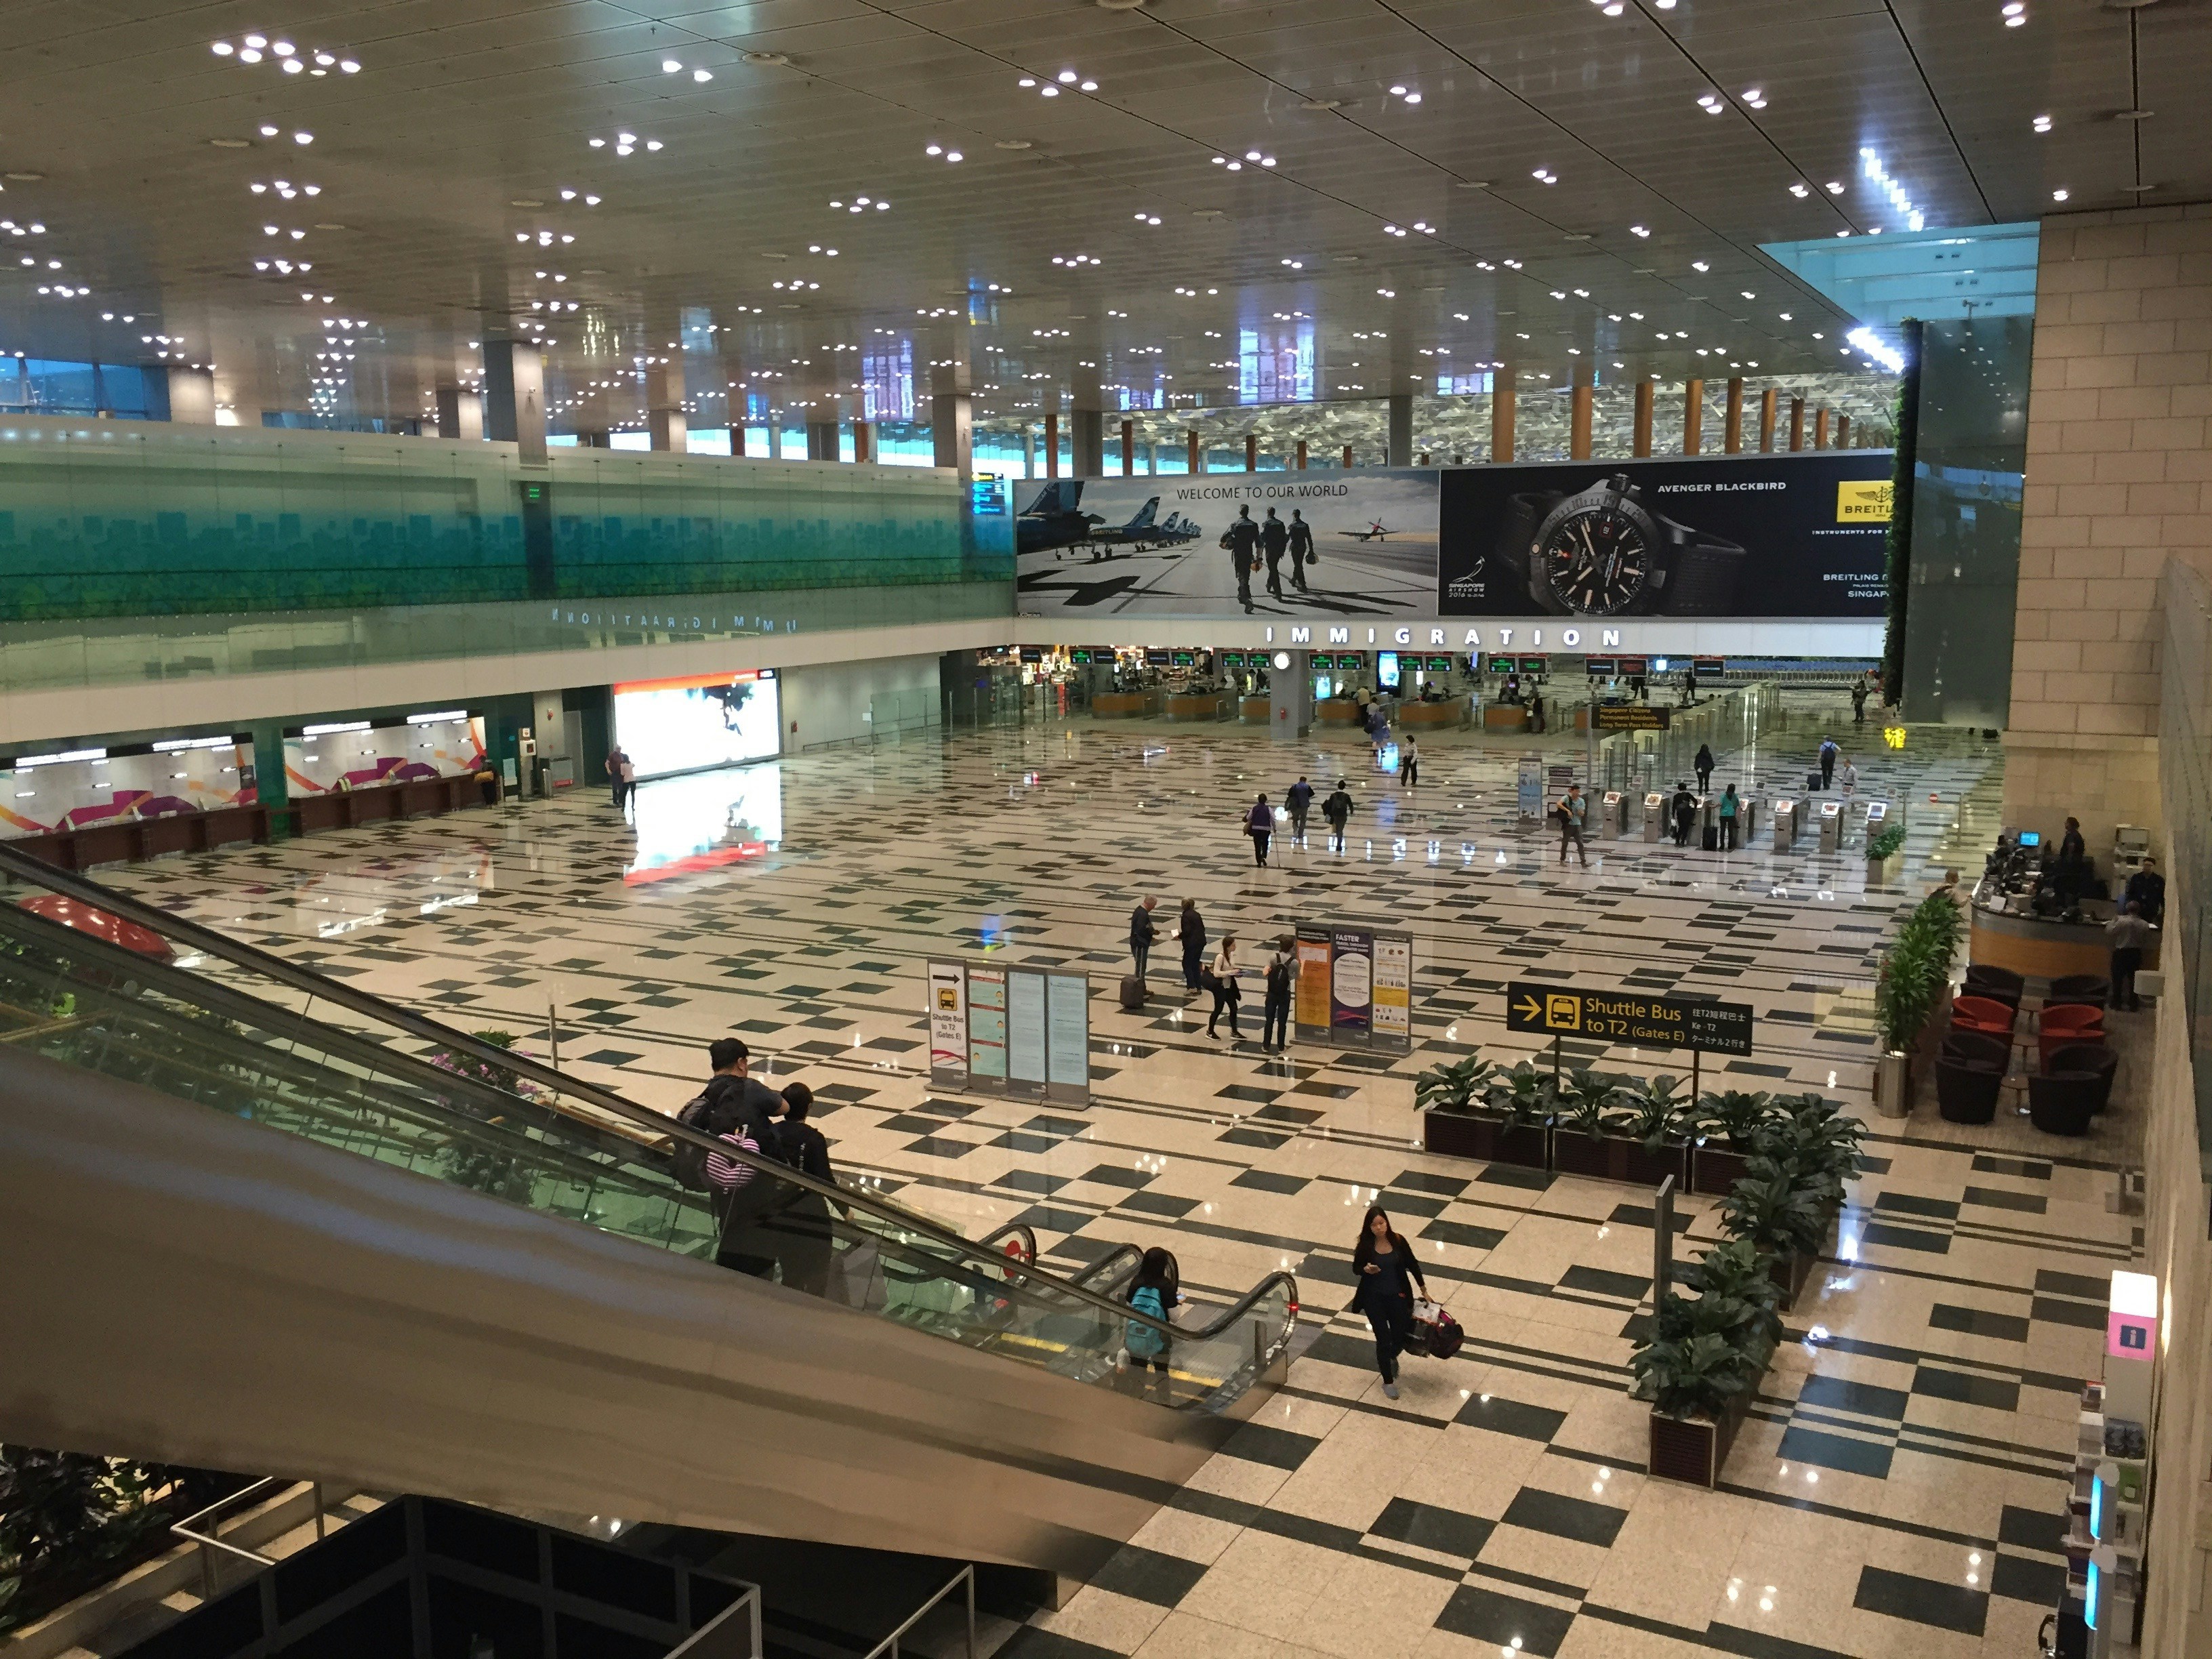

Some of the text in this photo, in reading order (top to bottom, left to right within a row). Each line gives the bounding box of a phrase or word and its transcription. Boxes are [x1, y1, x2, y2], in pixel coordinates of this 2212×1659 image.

[1177, 485, 1348, 499] WELCOME TO OUR WORLD
[1658, 482, 1786, 493] AVENGER BLACKBIRD
[1266, 627, 1620, 647] IMMIGRATION
[1336, 934, 1359, 943] FASTER
[1586, 998, 1681, 1021] Shuttle Bus
[1586, 1019, 1685, 1043] to T2 (Gates E)
[1707, 1023, 1717, 1031] T2
[936, 1031, 954, 1039] (Gates
